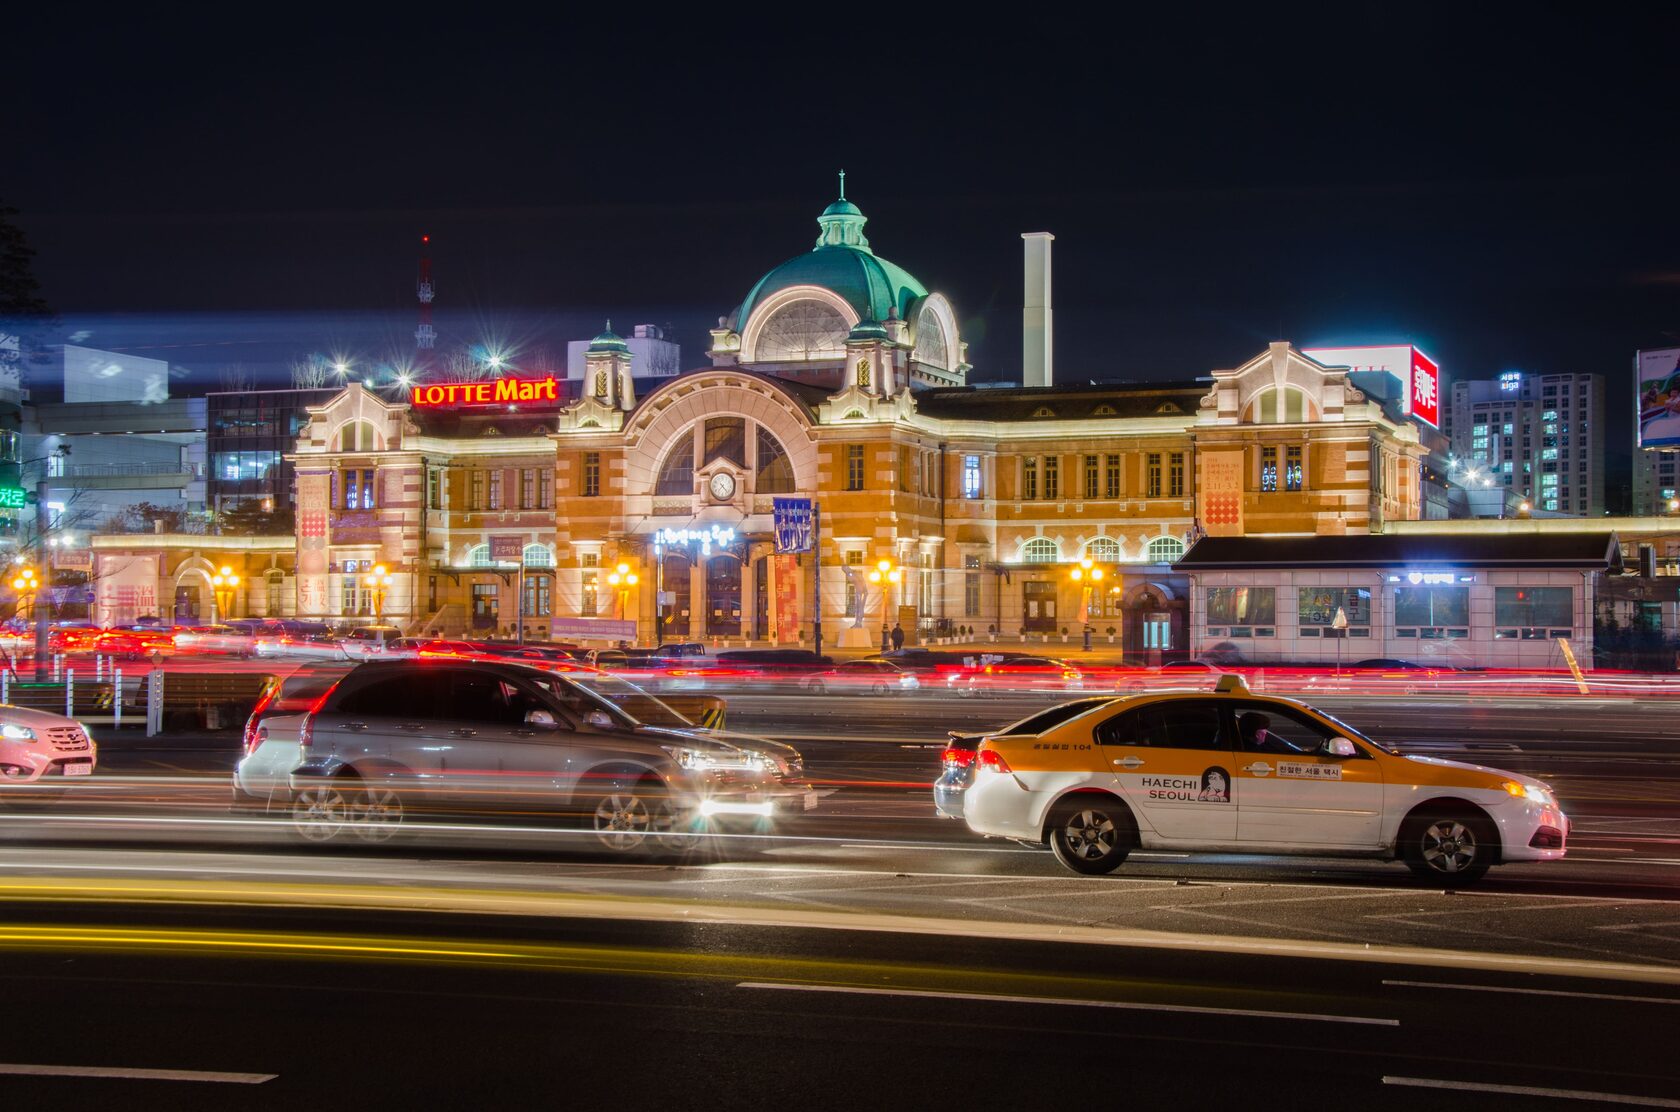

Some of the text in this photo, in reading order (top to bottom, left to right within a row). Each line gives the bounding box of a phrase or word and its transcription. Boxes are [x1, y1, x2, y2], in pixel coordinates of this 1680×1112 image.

[414, 377, 556, 404] LOTTE Mart
[1279, 765, 1302, 775] 친절한
[1305, 766, 1320, 776] 서울
[1323, 768, 1339, 777] 택시
[1141, 777, 1197, 790] HAECHI
[1149, 789, 1196, 802] SEOUL
